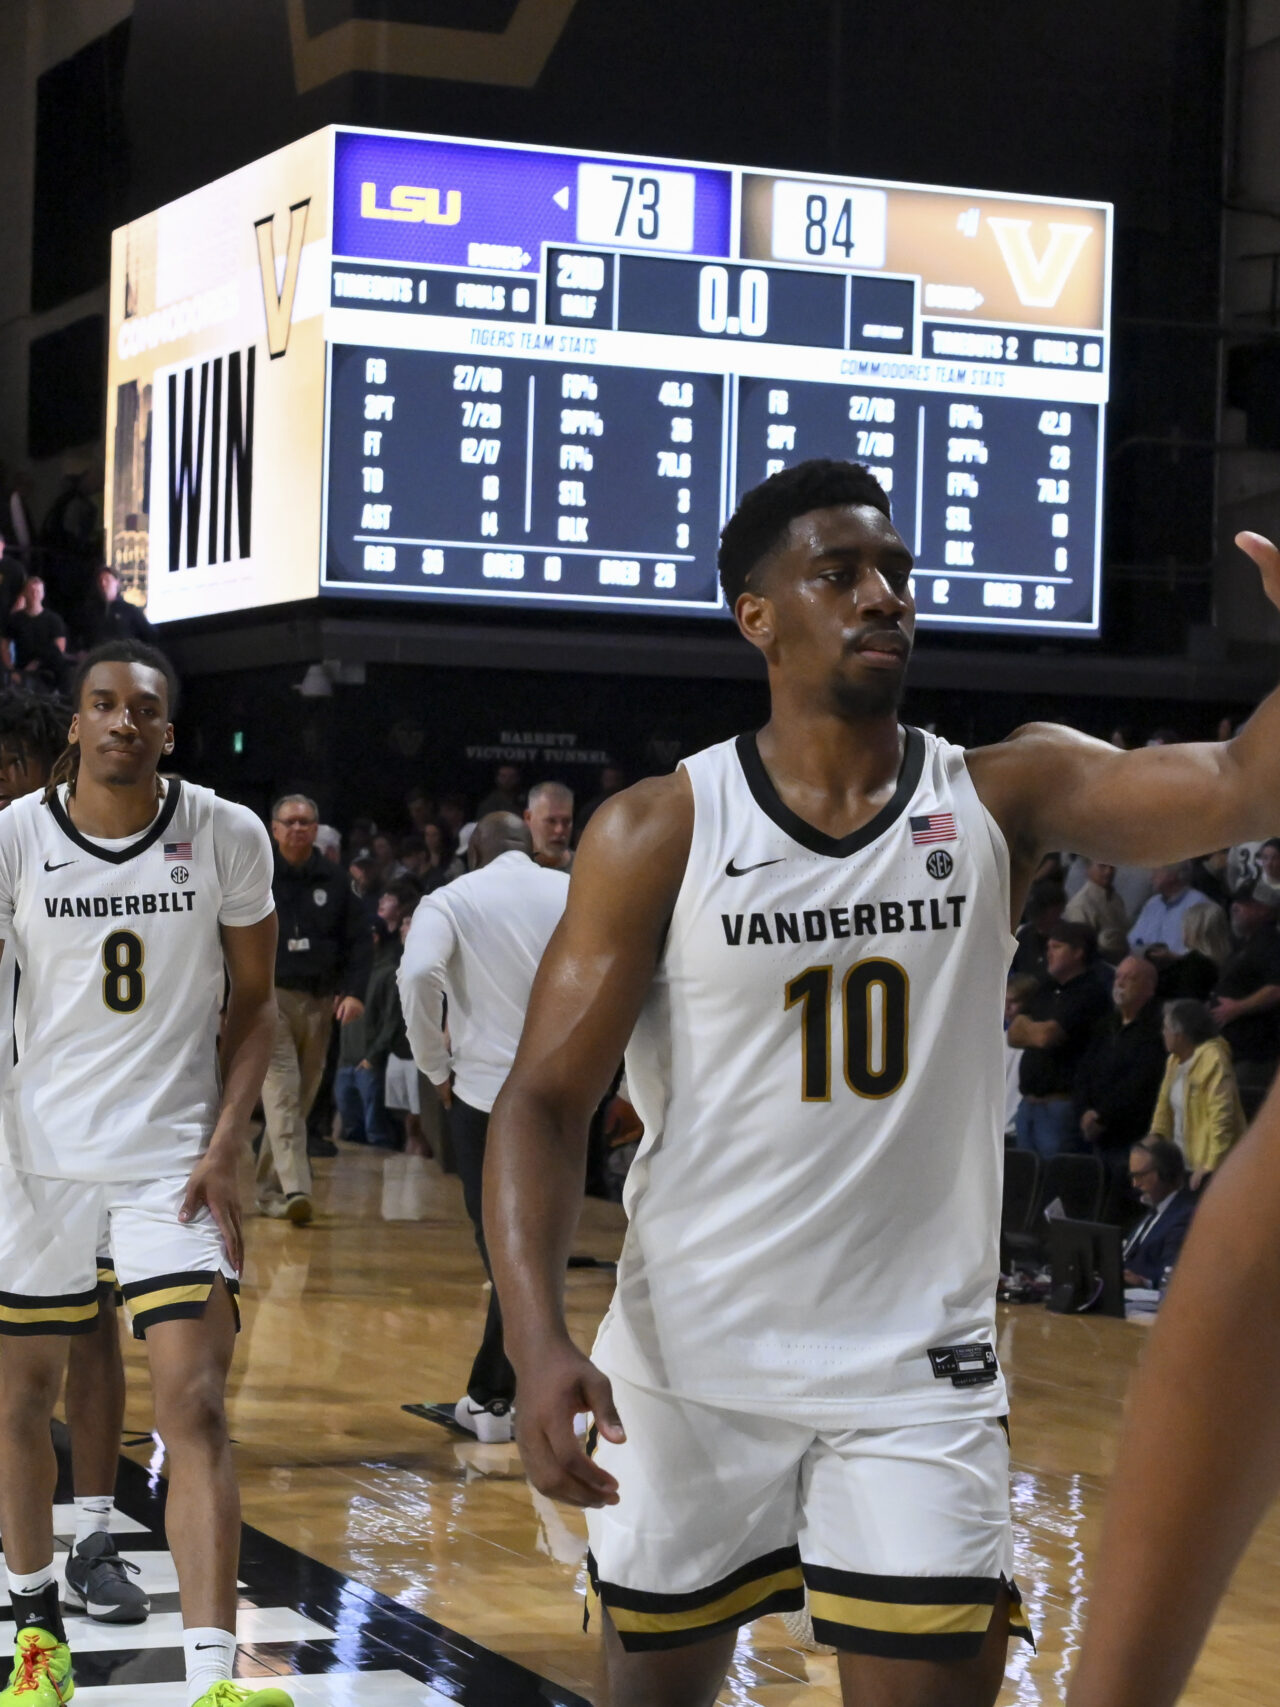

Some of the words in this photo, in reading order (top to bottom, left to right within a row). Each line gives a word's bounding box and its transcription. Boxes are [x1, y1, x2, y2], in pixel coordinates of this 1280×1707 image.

[360, 181, 461, 226] LSU
[610, 174, 660, 240] 73
[805, 194, 855, 258] 84
[255, 196, 312, 360] V
[986, 216, 1094, 308] V
[699, 265, 769, 337] 0.0
[469, 327, 515, 348] TIGERS
[519, 331, 554, 351] TEAM
[558, 335, 597, 355] STATS
[1005, 337, 1019, 361] 2
[839, 357, 931, 382] COMMODORES
[935, 365, 966, 385] TEAM
[971, 370, 1006, 389] STATS
[168, 344, 256, 572] WIN
[466, 746, 538, 762] VICTORY
[543, 748, 610, 764] TUNNEL
[170, 865, 189, 885] SEC
[926, 850, 954, 880] SEC
[44, 890, 196, 918] VANDERBILT
[720, 895, 967, 946] VANDERBILT
[102, 928, 146, 1015] 8
[783, 956, 911, 1102] 10
